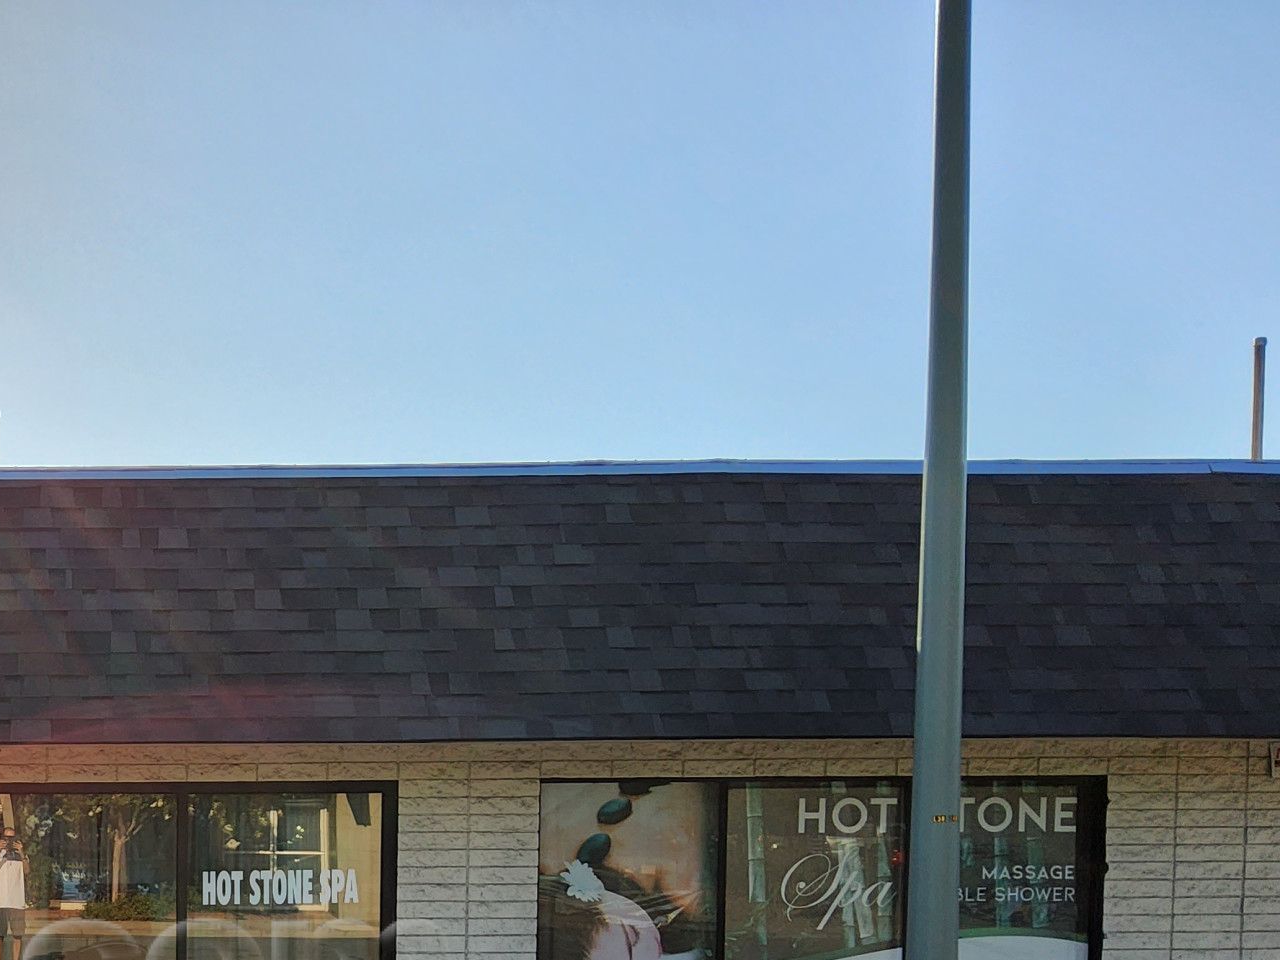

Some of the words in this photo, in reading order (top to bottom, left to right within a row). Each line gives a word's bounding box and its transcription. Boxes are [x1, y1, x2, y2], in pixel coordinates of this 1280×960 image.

[799, 797, 898, 834] HOT
[959, 796, 1078, 833] TONE
[201, 869, 244, 905] HOT
[249, 869, 315, 905] STONE
[319, 868, 360, 905] SPA
[982, 865, 1076, 880] MASSAGE
[781, 853, 897, 931] Spa
[957, 887, 987, 902] BLE
[995, 887, 1076, 902] SHOWER
